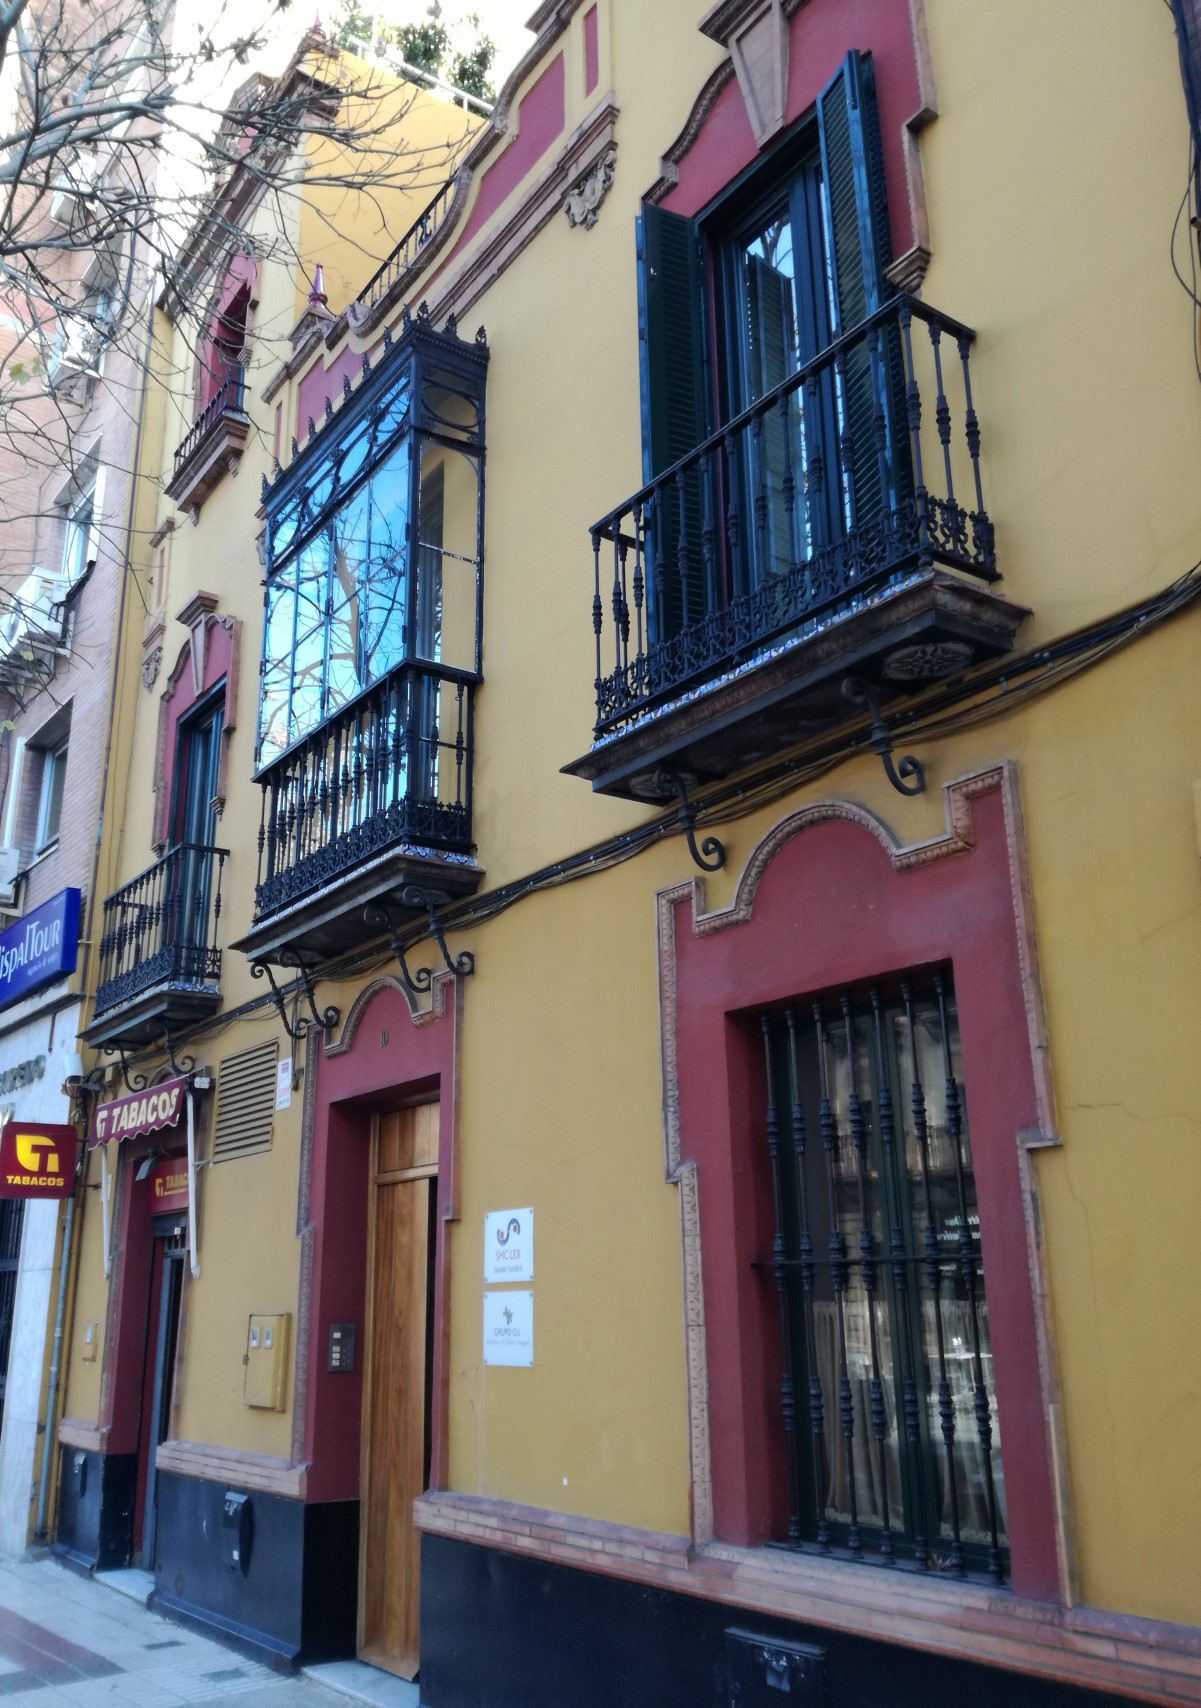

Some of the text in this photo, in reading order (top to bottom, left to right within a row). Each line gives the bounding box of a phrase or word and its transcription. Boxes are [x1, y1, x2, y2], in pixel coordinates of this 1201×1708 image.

[112, 1088, 179, 1134] TABACOS
[6, 1175, 64, 1187] TABACOS
[496, 1249, 520, 1261] SMC LEX
